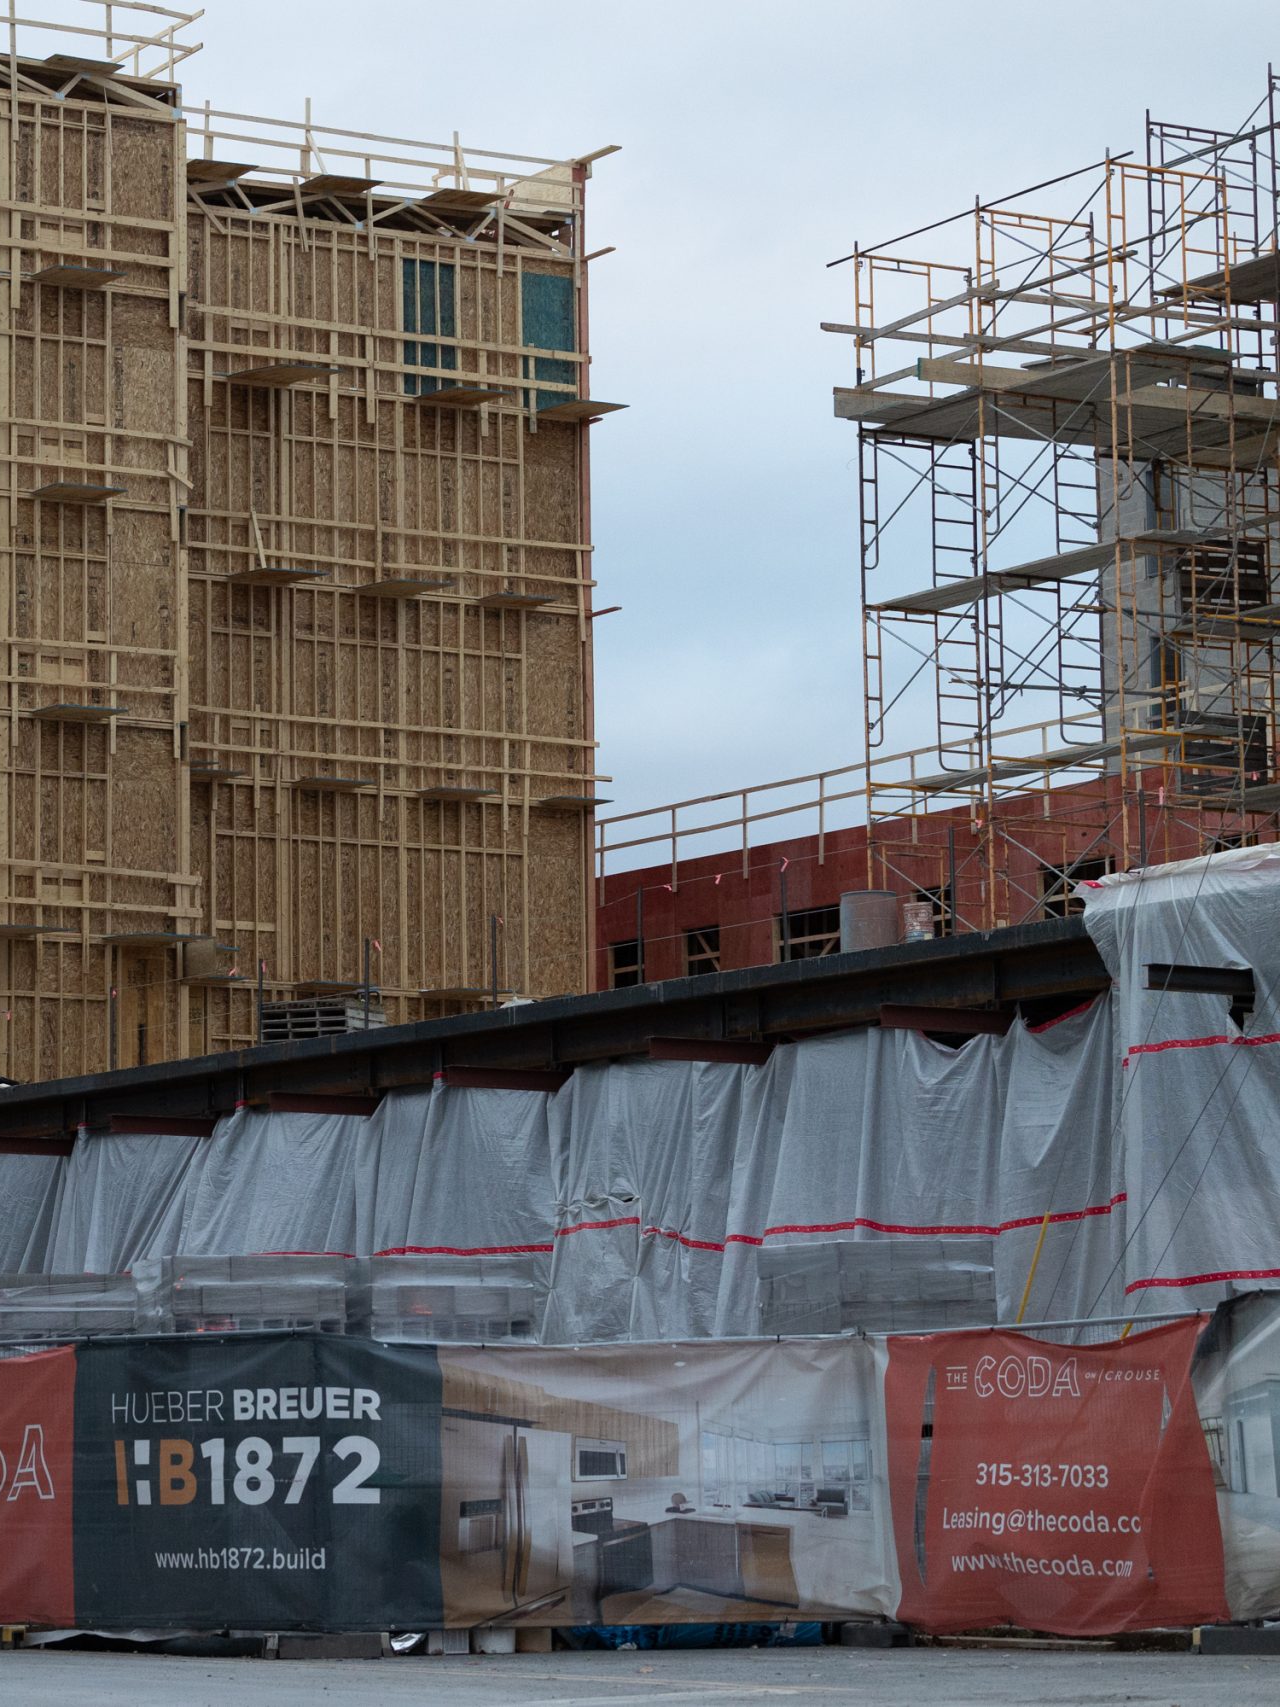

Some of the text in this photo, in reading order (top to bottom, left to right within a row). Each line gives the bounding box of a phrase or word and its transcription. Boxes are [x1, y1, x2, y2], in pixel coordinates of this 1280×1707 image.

[946, 1372, 968, 1383] THE
[974, 1355, 1081, 1398] CODA
[111, 1387, 382, 1424] HUEBER BREUER
[975, 1462, 1109, 1488] 315-313-7033
[154, 1547, 327, 1570] www.hb1872.build
[951, 1551, 1133, 1577] www.thecoda.com
